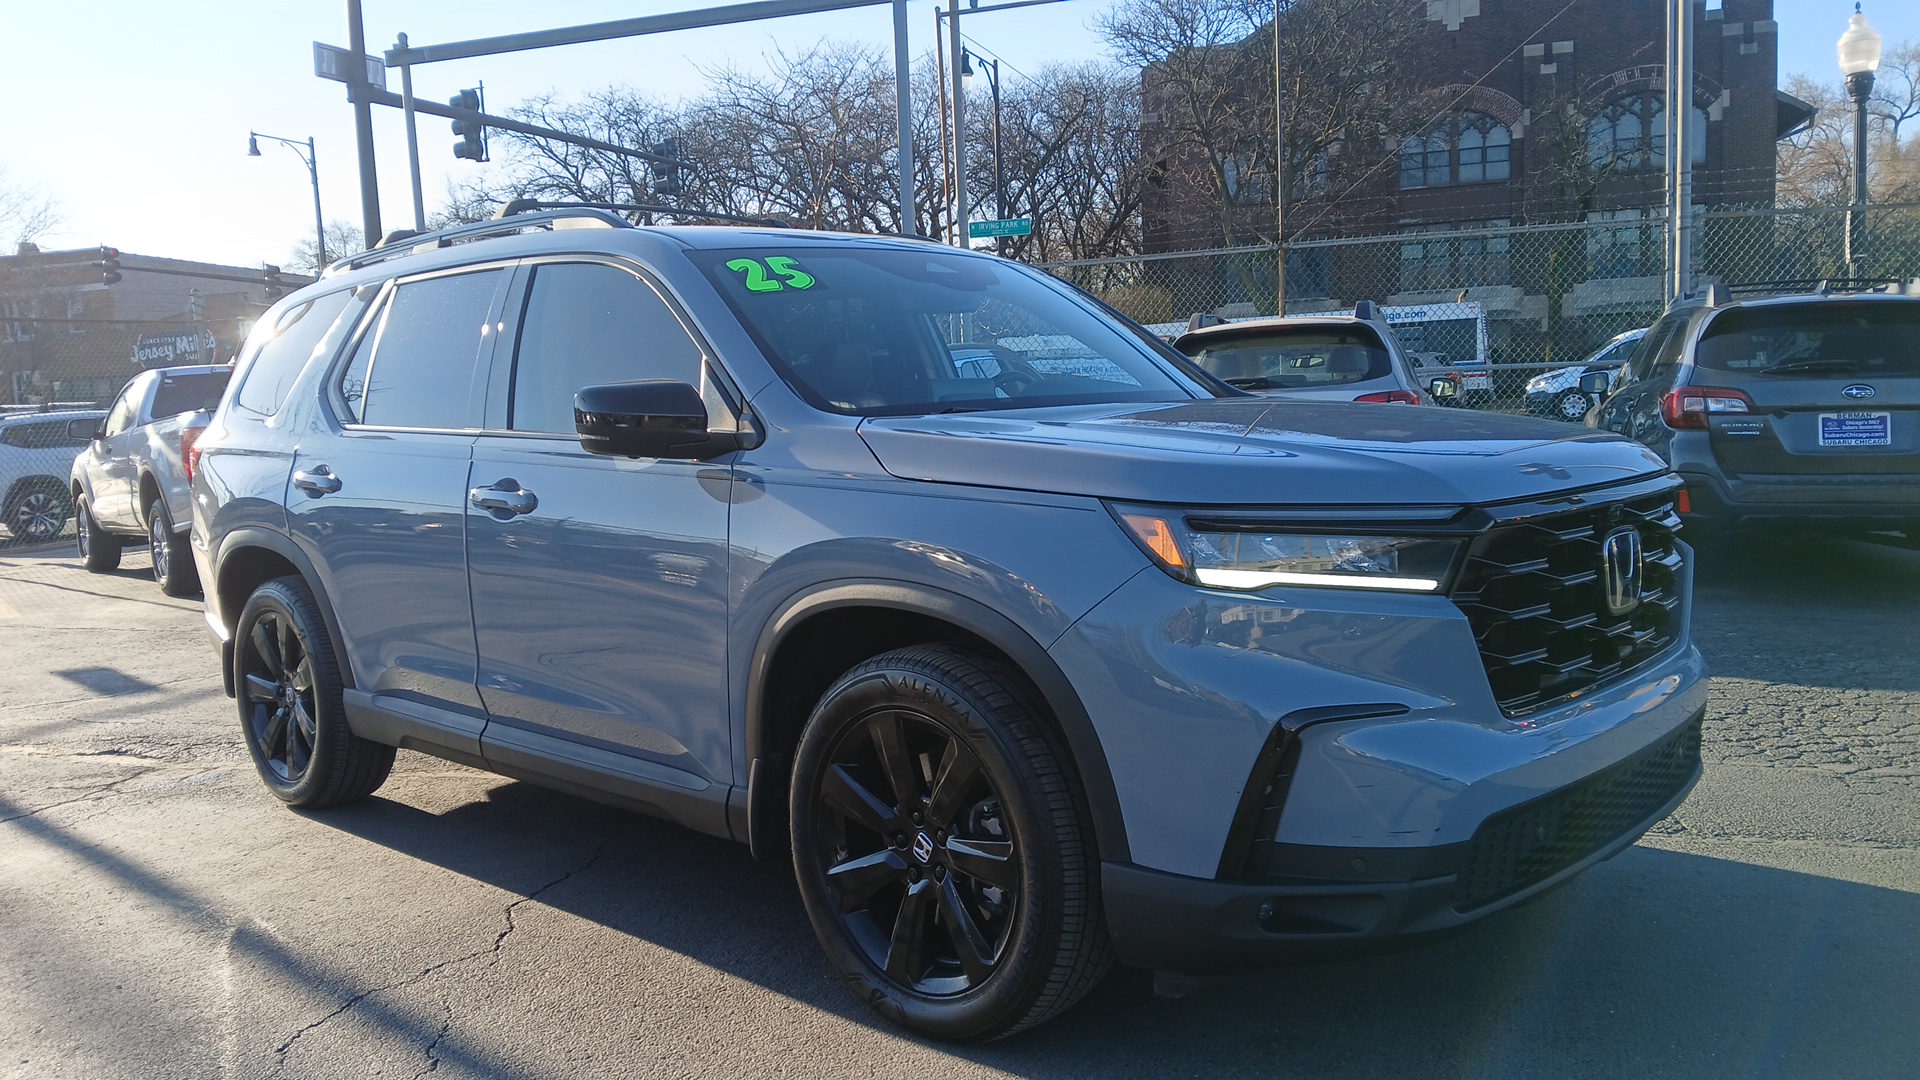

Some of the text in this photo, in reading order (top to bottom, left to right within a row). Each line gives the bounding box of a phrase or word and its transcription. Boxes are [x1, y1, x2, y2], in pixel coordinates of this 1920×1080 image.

[1000, 221, 1018, 229] PARK
[725, 256, 816, 292] 25
[130, 344, 174, 363] Jersey
[898, 676, 971, 724] ALENZA
